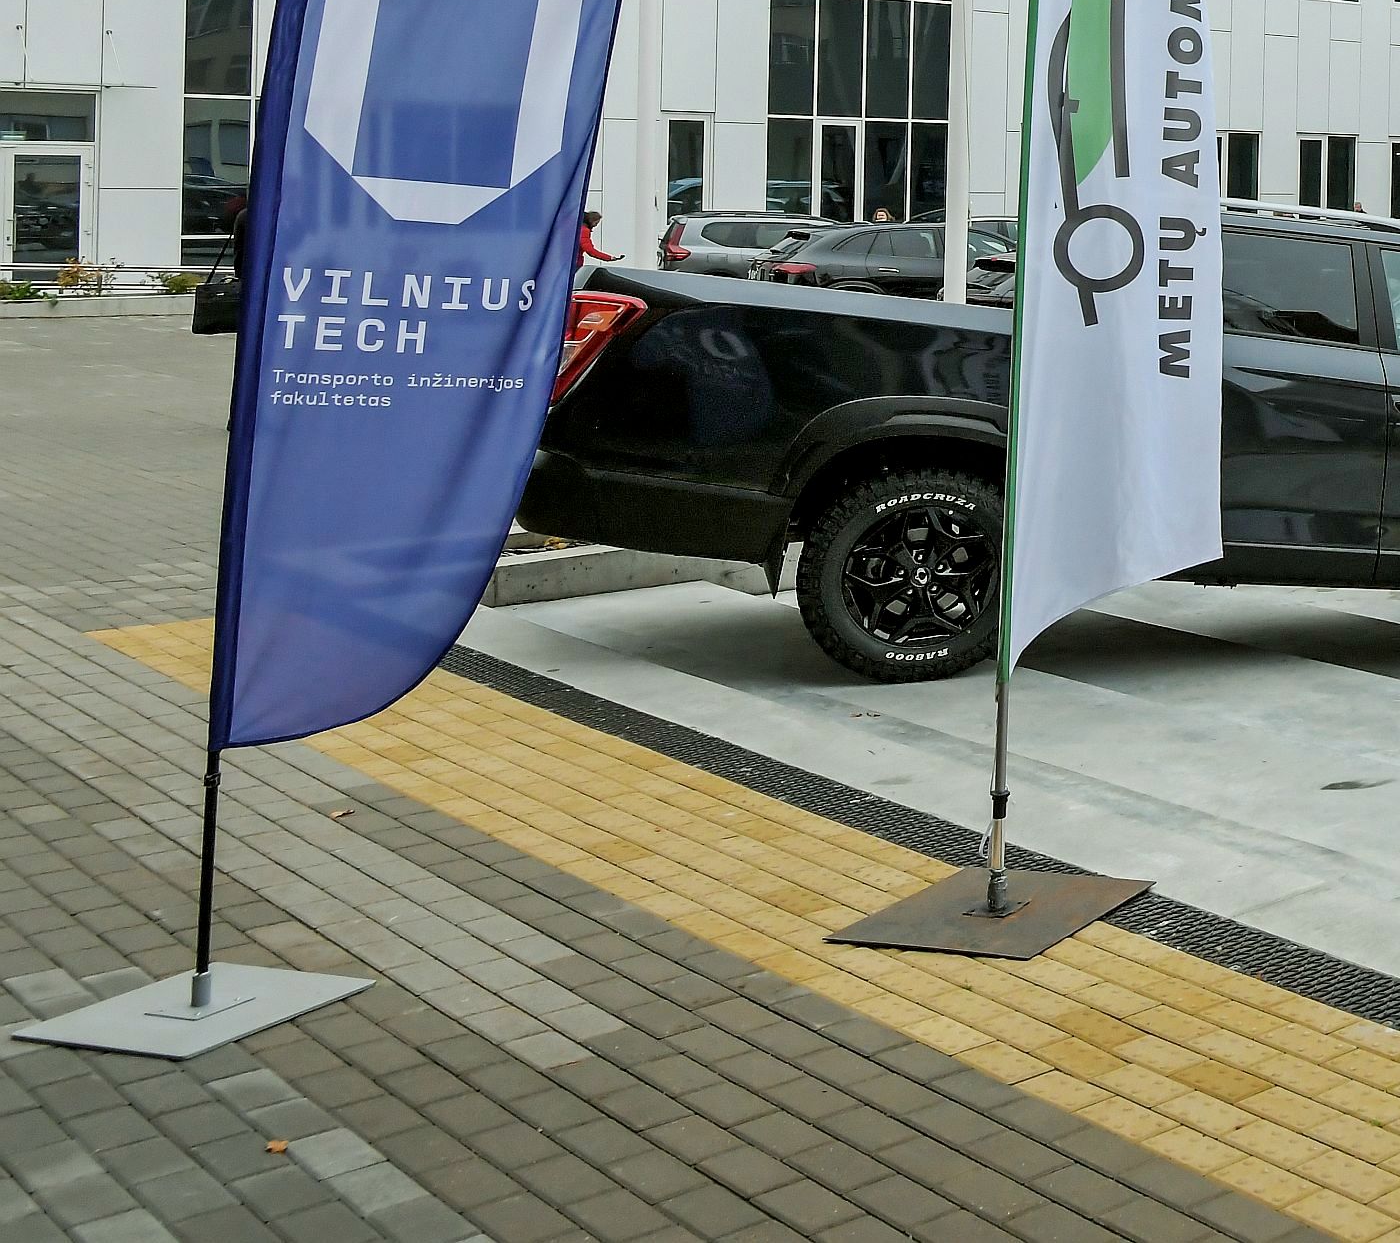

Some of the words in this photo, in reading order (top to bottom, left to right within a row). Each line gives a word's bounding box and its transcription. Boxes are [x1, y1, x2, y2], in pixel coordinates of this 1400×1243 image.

[282, 267, 536, 312] VILNIUS
[1157, 216, 1207, 378] METŲ
[277, 314, 427, 354] TECH
[272, 369, 394, 388] Transporto
[407, 373, 524, 392] inžinerijos
[270, 391, 391, 407] fakultetas
[875, 492, 977, 514] ROADCRUZA
[885, 647, 949, 661] RA8000
